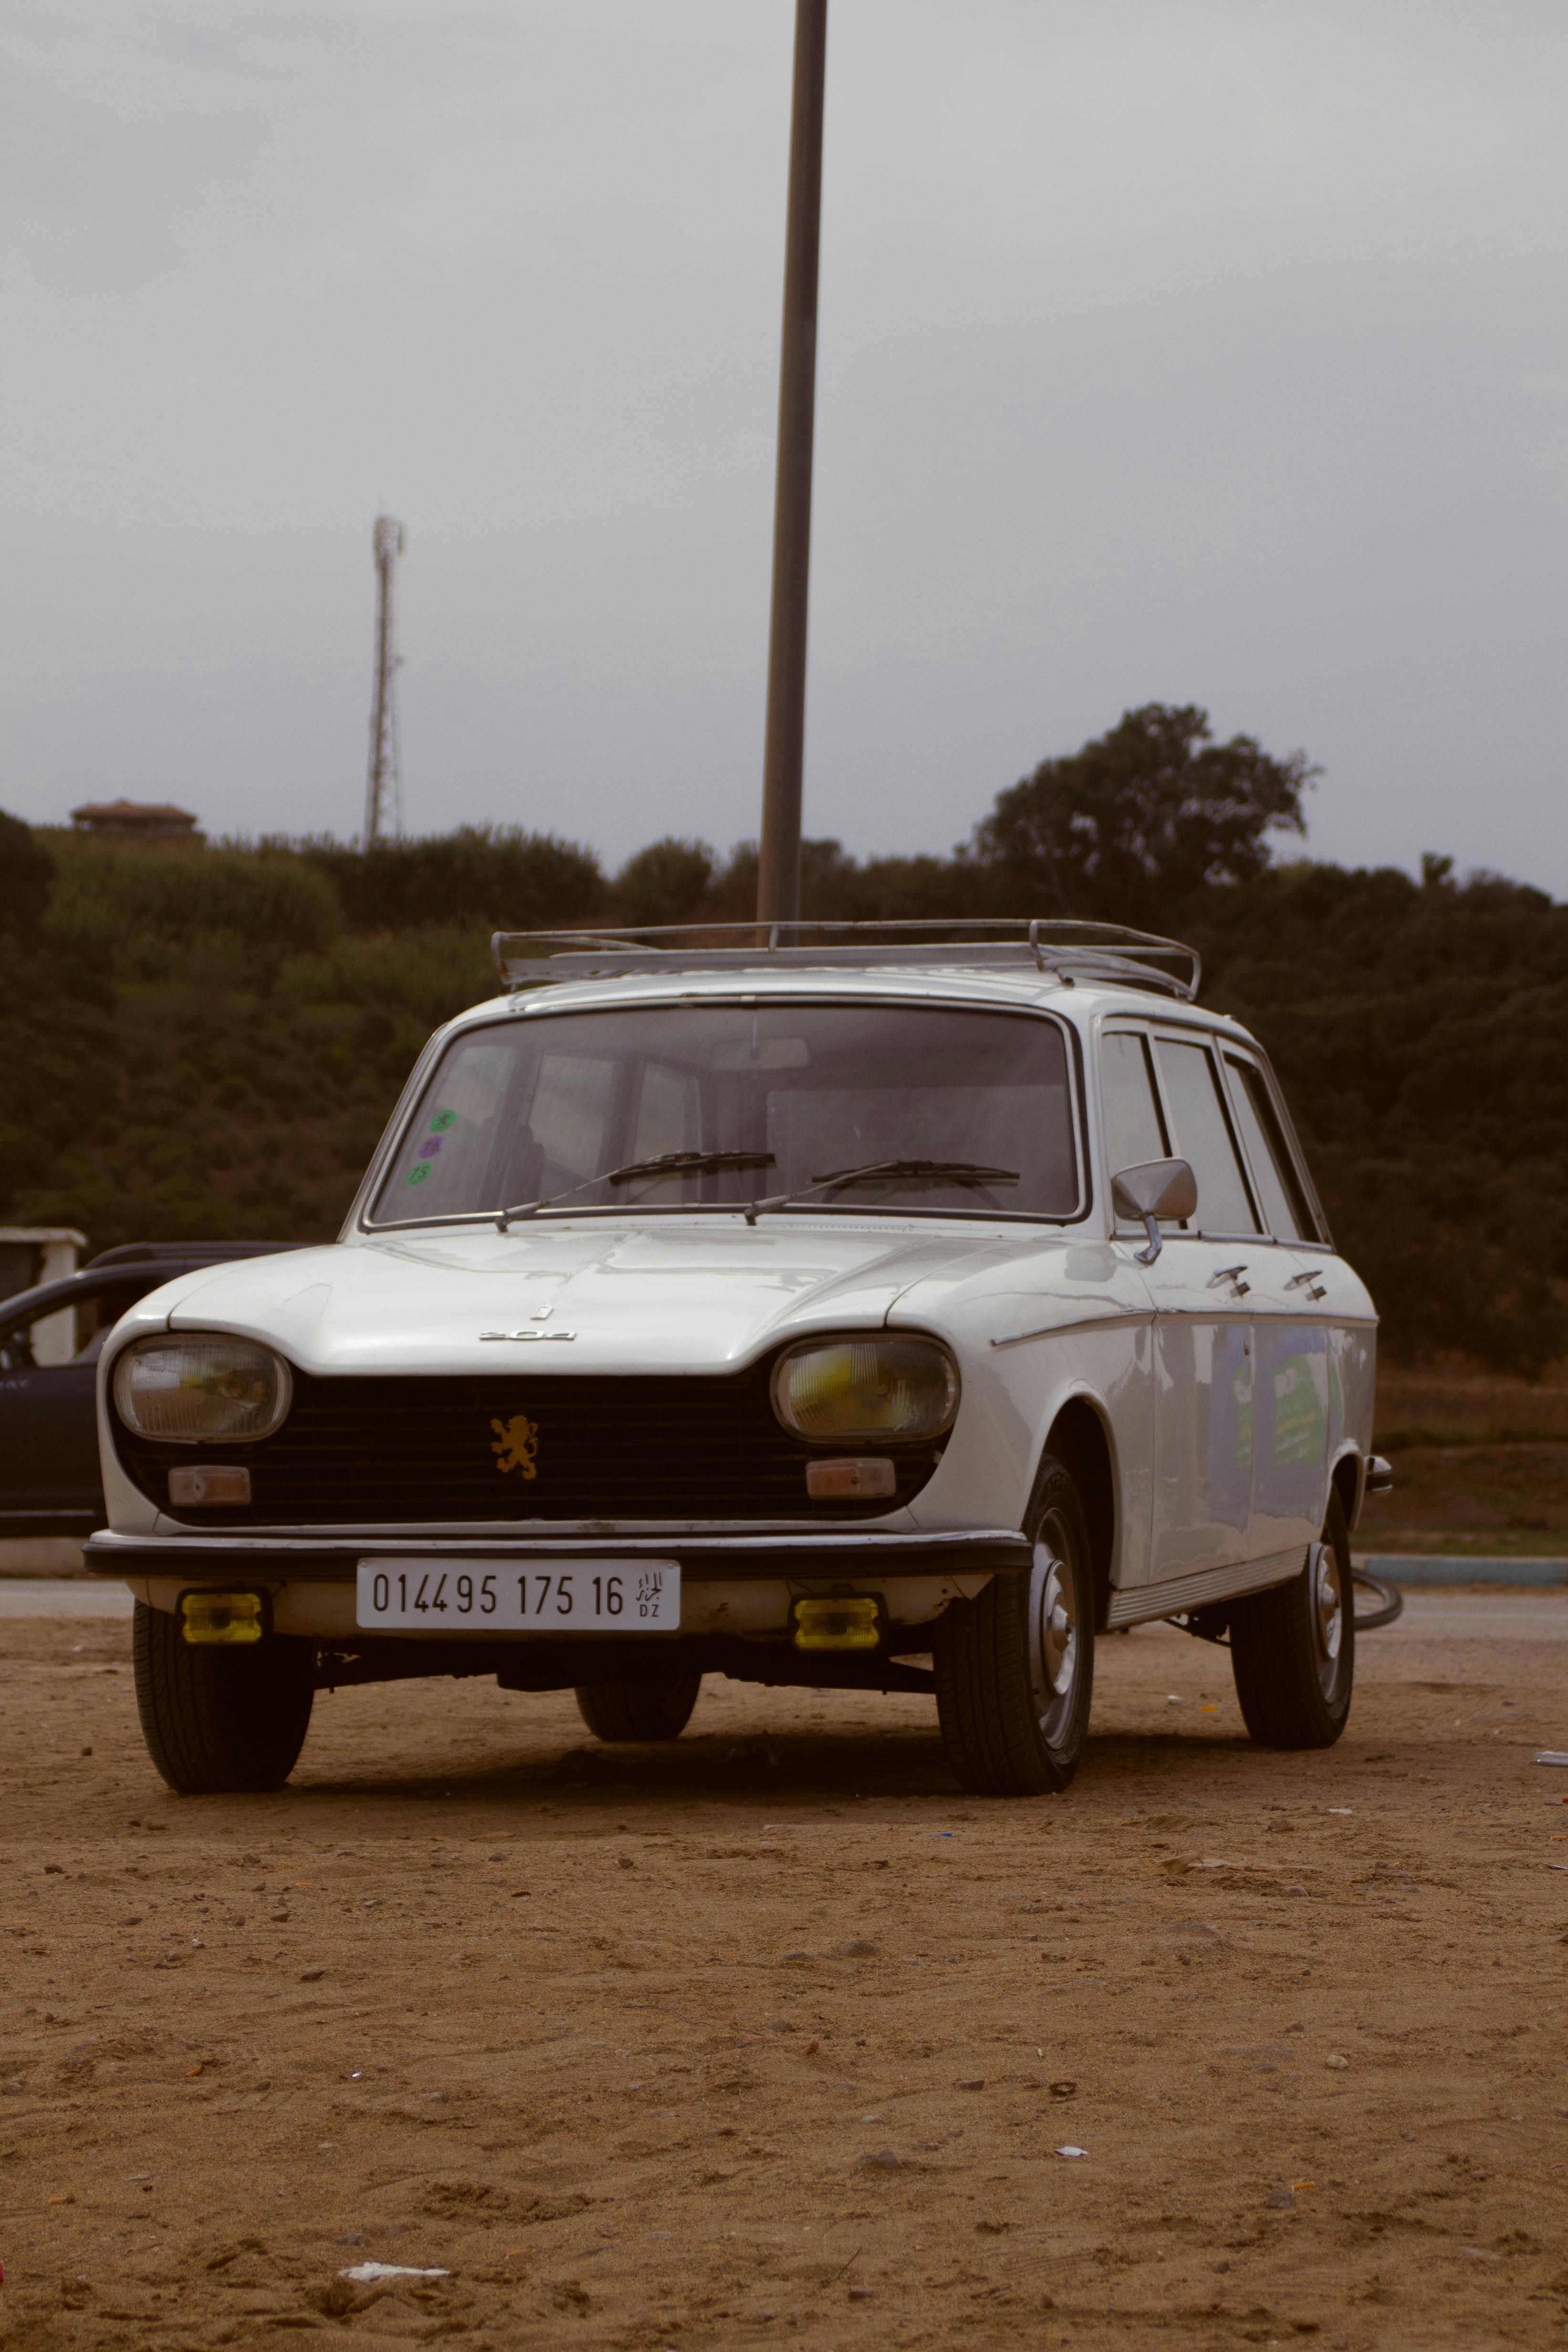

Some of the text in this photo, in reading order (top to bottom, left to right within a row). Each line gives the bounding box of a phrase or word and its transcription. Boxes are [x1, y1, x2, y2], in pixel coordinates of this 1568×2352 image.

[373, 1574, 623, 1616] 014495 175 16
[639, 1604, 659, 1617] DZ
